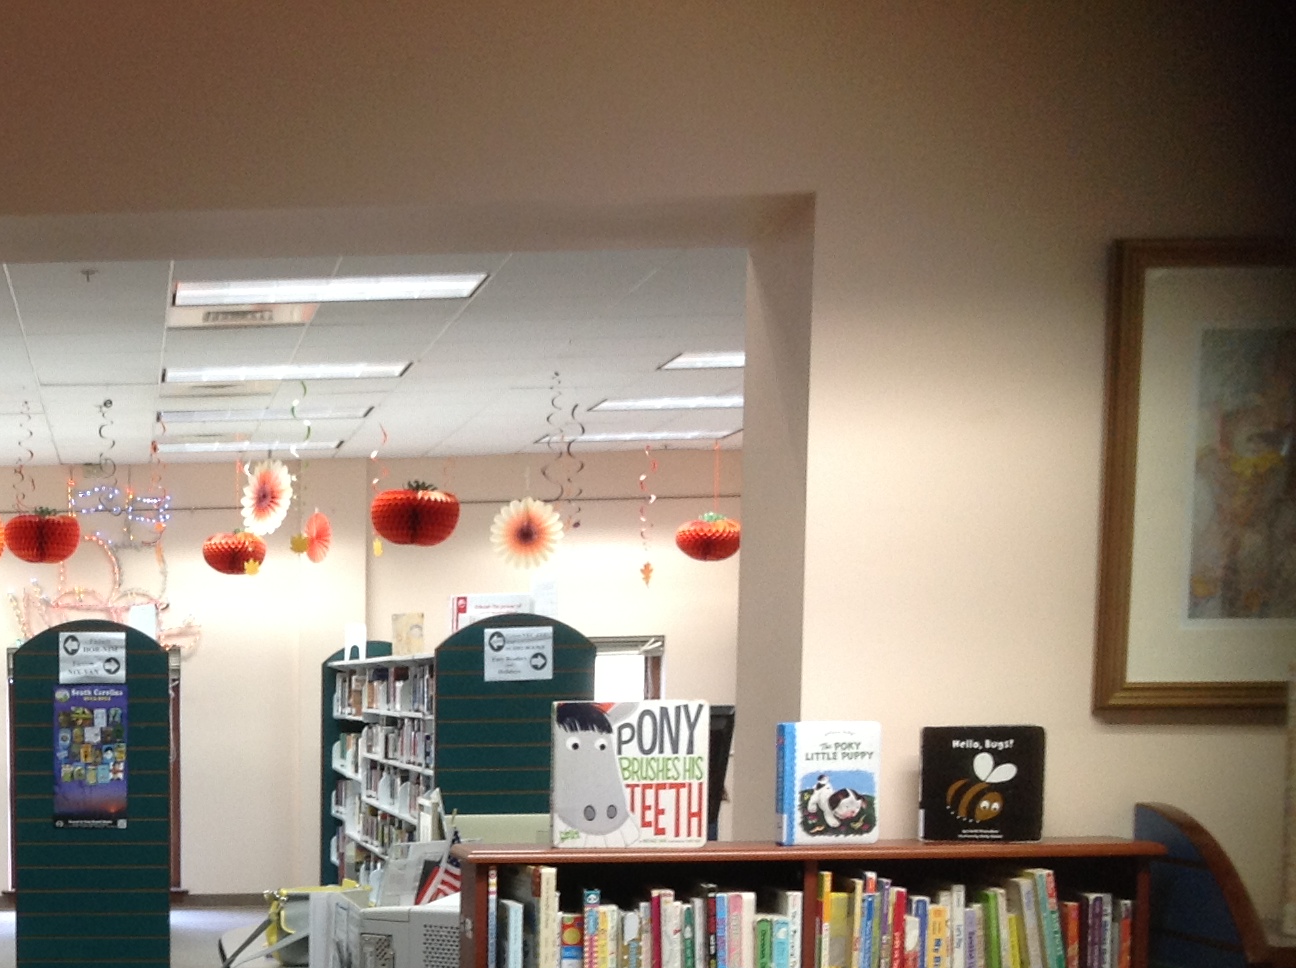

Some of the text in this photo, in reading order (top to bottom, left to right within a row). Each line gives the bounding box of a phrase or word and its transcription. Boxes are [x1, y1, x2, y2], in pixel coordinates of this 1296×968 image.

[71, 688, 91, 696] South
[617, 703, 704, 756] PONY
[834, 742, 862, 751] POKY
[951, 739, 1015, 750] Hello, Bugs!
[805, 751, 874, 761] LITTLE PUPPY
[619, 756, 704, 781] BRUSHES HIS
[624, 782, 704, 838] TEETH
